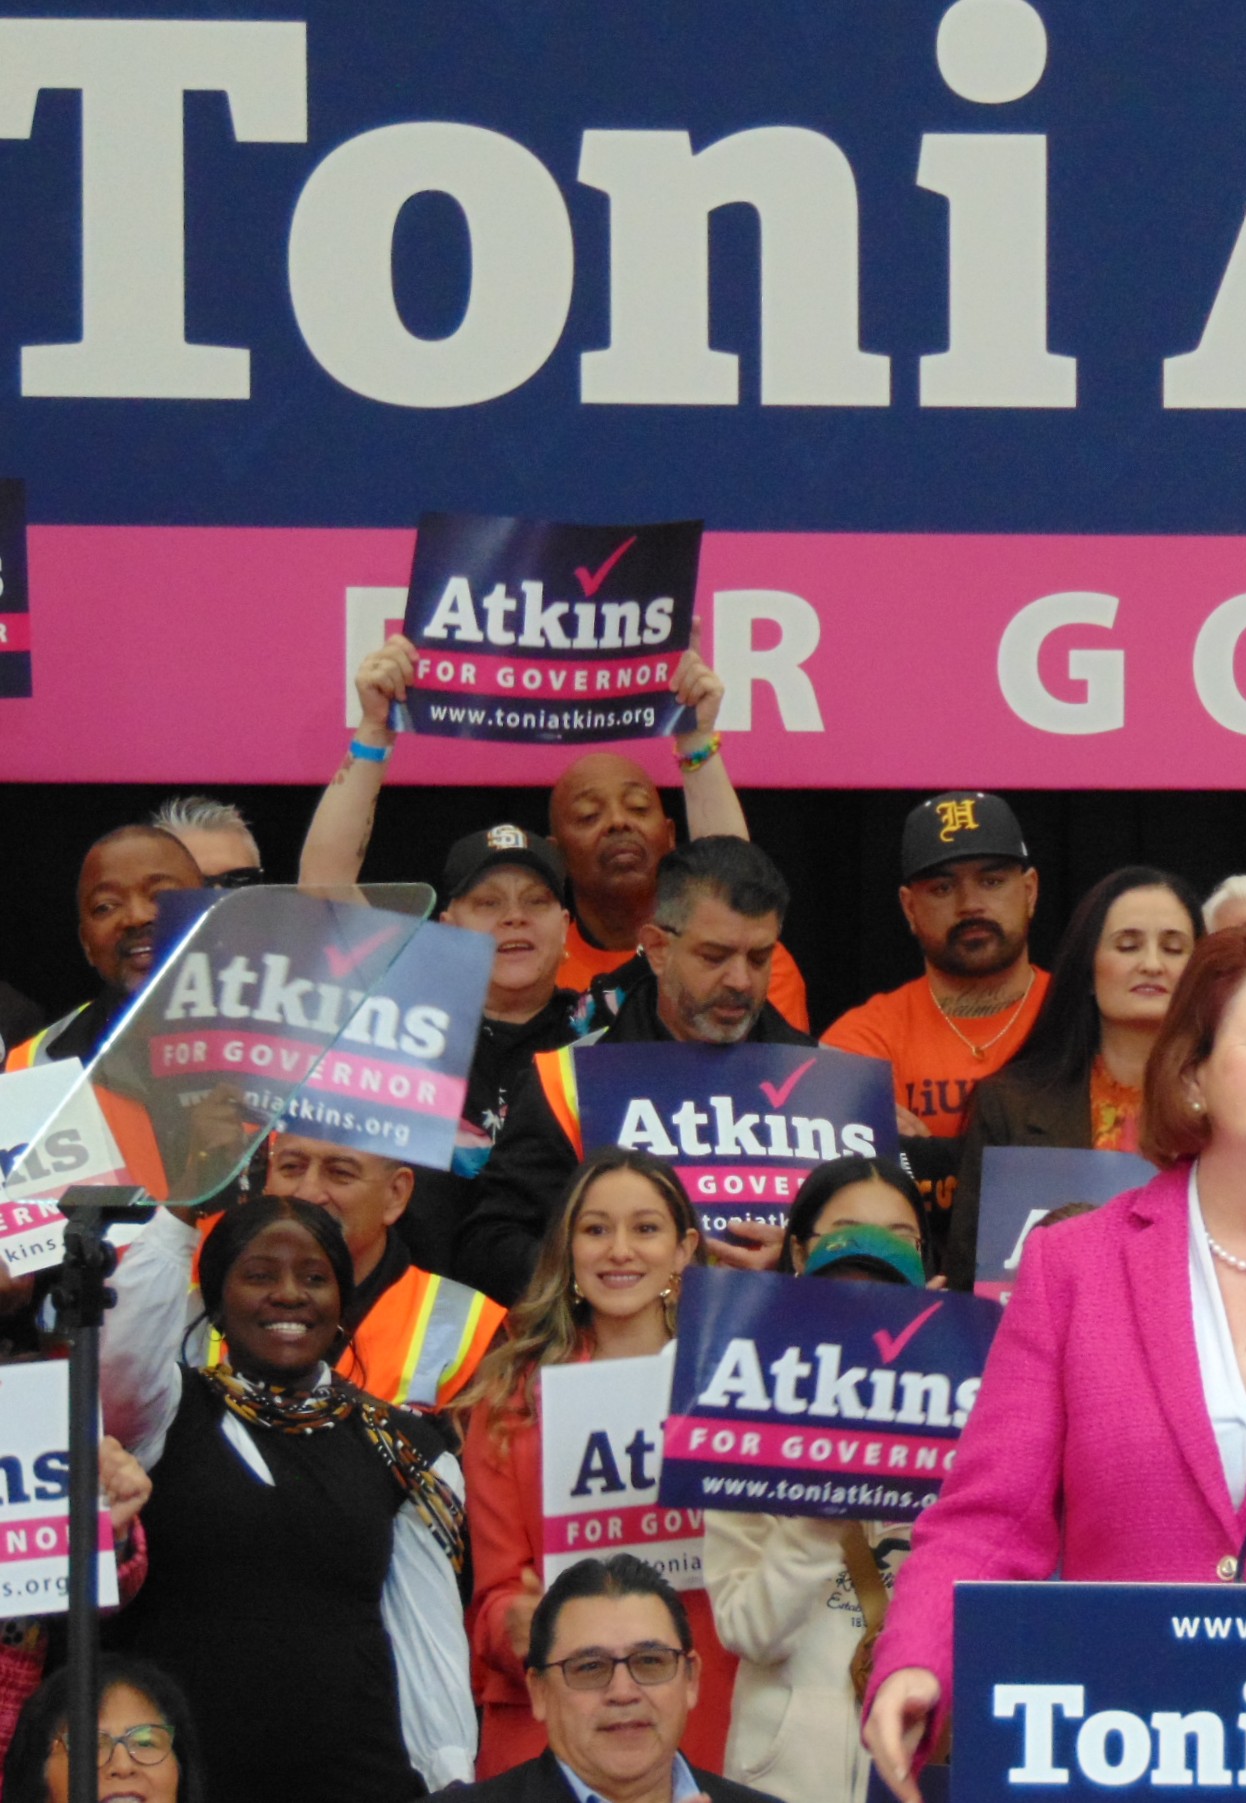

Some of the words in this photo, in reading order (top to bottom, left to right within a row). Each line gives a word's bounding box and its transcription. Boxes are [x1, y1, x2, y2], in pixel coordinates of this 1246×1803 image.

[0, 0, 1076, 408] Toni
[423, 575, 674, 650] Atkins
[345, 586, 825, 734] FR
[418, 659, 476, 685] FOR
[497, 662, 668, 691] GOVERNOR
[430, 704, 655, 730] www.toniatkins.org
[164, 952, 450, 1060] Atkins
[163, 1041, 207, 1066] FOR
[222, 1040, 437, 1106] GOVERNOR
[617, 1096, 878, 1161] Atkins
[698, 1175, 806, 1196] GOVE
[698, 1338, 982, 1429] Atkins
[689, 1427, 762, 1456] FOR
[567, 1516, 623, 1545] FOR
